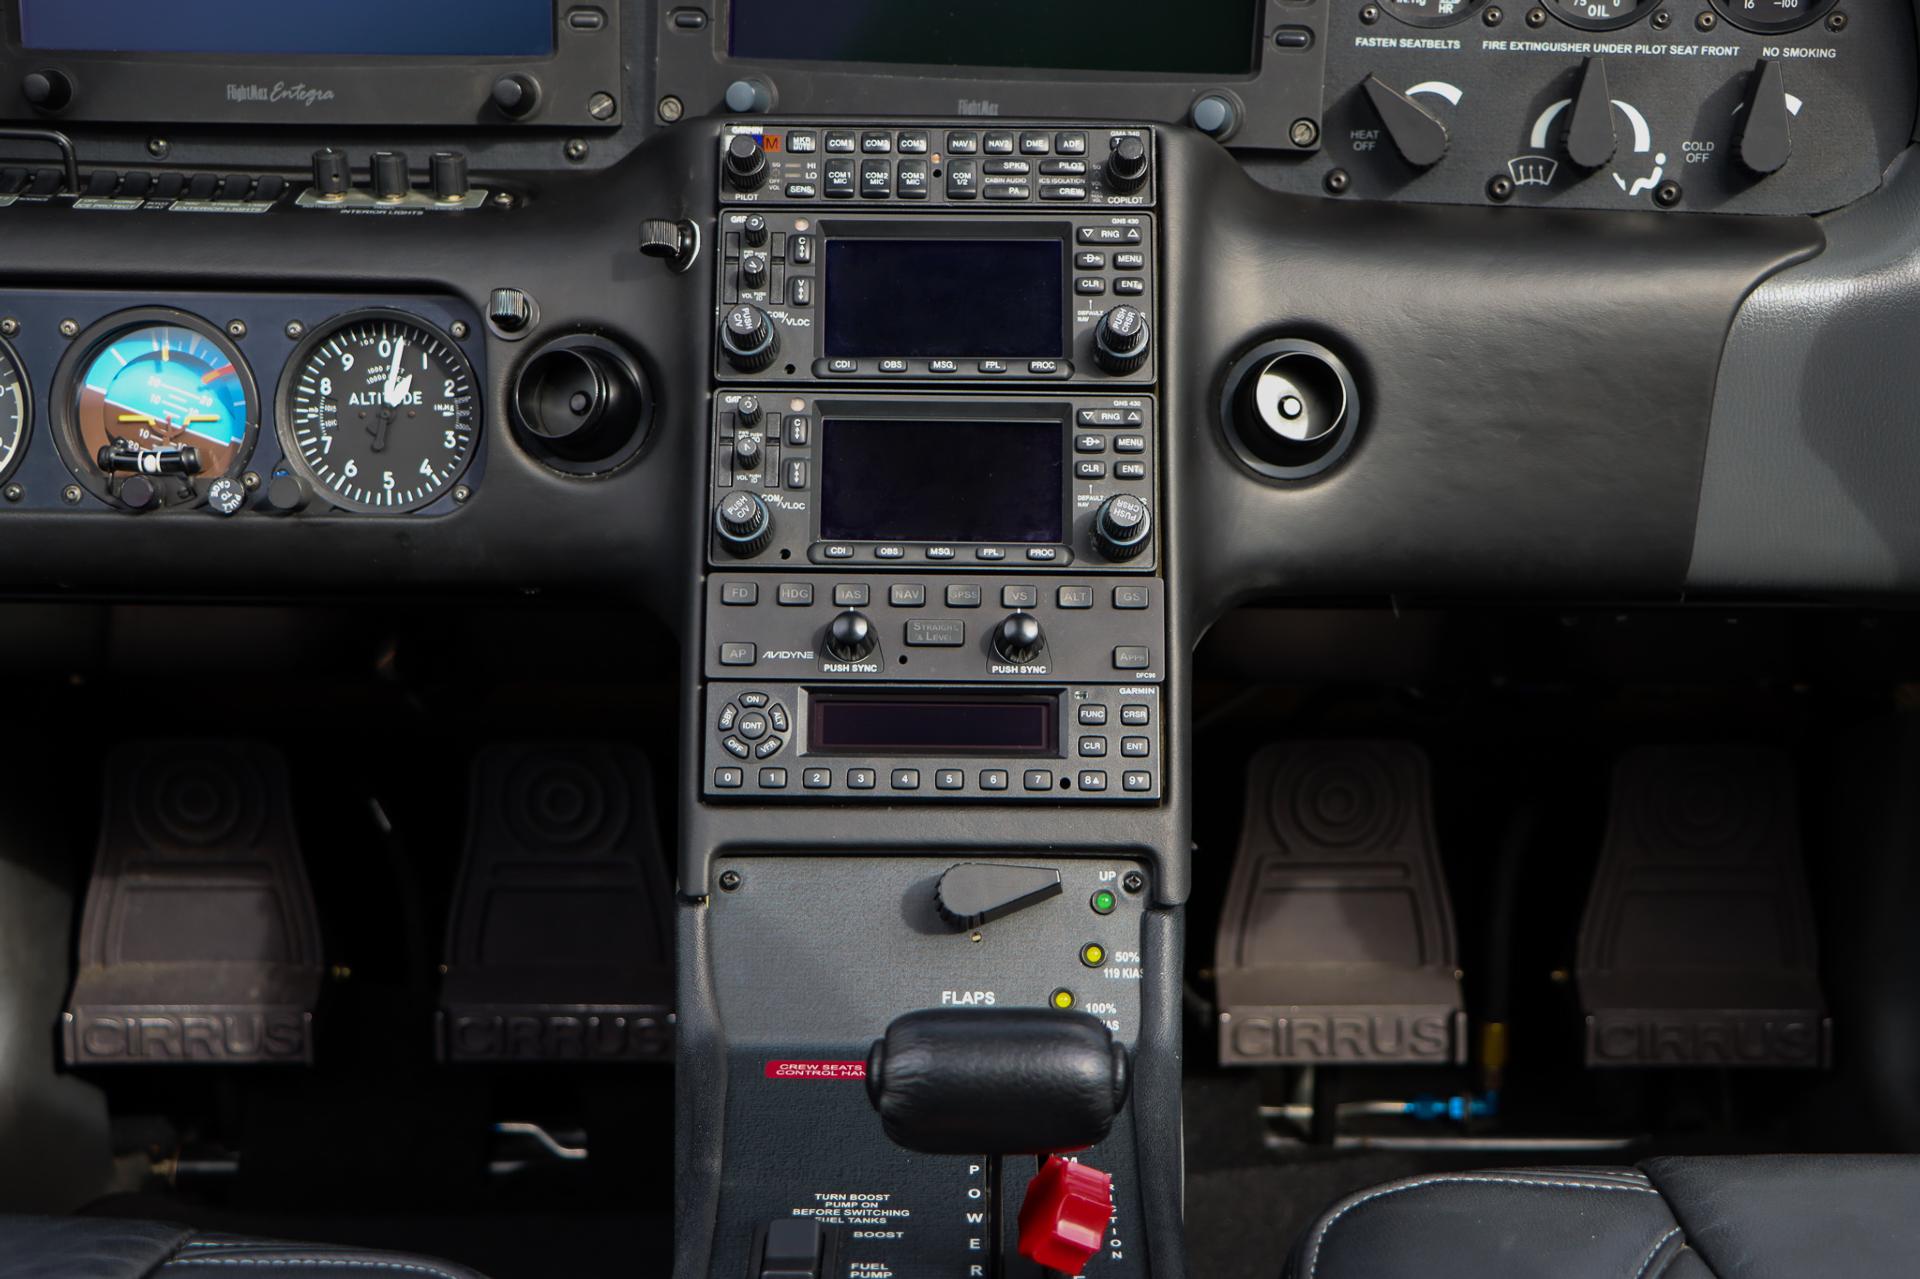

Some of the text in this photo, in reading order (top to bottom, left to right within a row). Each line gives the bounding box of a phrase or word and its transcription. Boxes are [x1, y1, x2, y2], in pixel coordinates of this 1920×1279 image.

[1438, 4, 1454, 14] HR
[1587, 5, 1610, 17] OIL
[1355, 37, 1461, 50] FASTEN SEATBELTS
[1482, 40, 1740, 57] FIRE EXTINGUISHER UNDER PILOT SEAT FRONT
[1762, 47, 1836, 59] NO SMOKING
[270, 80, 335, 107] Entegra
[1350, 130, 1380, 139] HEAT
[765, 138, 778, 149] M
[1353, 141, 1376, 151] OFF
[1682, 141, 1714, 151] COLD
[1686, 153, 1709, 163] OFF
[1107, 196, 1143, 204] COPILOT
[1101, 230, 1119, 238] RNG
[1118, 255, 1142, 263] MENU
[1082, 280, 1099, 288] CLR
[742, 308, 753, 330] PUSH
[1112, 308, 1127, 329] PUSH
[1121, 311, 1135, 332] CRSR
[379, 340, 391, 358] 0
[341, 353, 354, 372] 9
[985, 361, 1000, 369] FPL
[1031, 361, 1055, 369] PROC
[320, 377, 332, 395] 8
[444, 379, 455, 397] 2
[348, 391, 423, 405] ALTIDE
[139, 428, 150, 439] 10
[444, 430, 456, 448] 3
[1118, 438, 1143, 446] MENU
[321, 436, 332, 454] 7
[344, 459, 357, 477] 6
[419, 458, 432, 476] 4
[1082, 464, 1099, 472] CLR
[1122, 465, 1138, 473] ENT
[383, 471, 395, 489] 5
[727, 495, 748, 515] PUSH
[1116, 499, 1139, 512] CRSR
[1113, 508, 1137, 521] PUSH
[830, 547, 846, 555] CDI
[1030, 548, 1054, 556] PROC
[732, 589, 748, 597] FD
[782, 589, 809, 598] HDG
[841, 590, 861, 599] IAS
[895, 590, 919, 599] NAV
[1012, 591, 1027, 600] VS
[1063, 592, 1086, 601] ALT
[1123, 592, 1140, 600] GS
[730, 649, 746, 658] AP
[762, 651, 814, 659] AVIDYNE
[823, 664, 877, 673] PUSH SYNC
[992, 666, 1047, 674] PUSH SYNC
[727, 740, 743, 752] OFF
[761, 741, 777, 753] VFR
[1083, 742, 1100, 750] CLR
[1126, 742, 1143, 750] ENT
[724, 774, 731, 782] 0
[813, 774, 820, 782] 2
[857, 774, 864, 782] 3
[901, 775, 908, 783] 4
[946, 775, 952, 783] 5
[990, 775, 997, 783] 6
[1084, 776, 1091, 784] 8
[1128, 776, 1135, 784] 9
[1099, 871, 1116, 881] UP
[1115, 951, 1140, 962] 50%
[1103, 968, 1120, 978] 119
[942, 991, 995, 1005] FLAPS
[1085, 1003, 1117, 1014] 100%
[84, 1015, 304, 1057] CIRRUS
[1231, 1016, 1445, 1057] CIRRUS
[1599, 1021, 1811, 1060] CIRRUS
[815, 1193, 846, 1201] TURN
[792, 1208, 910, 1217] BEFORE SWITCHING
[966, 1165, 983, 1276] POWER
[853, 1231, 904, 1239] BOOST
[851, 1263, 888, 1271] FUEL
[851, 1271, 893, 1279] PUMP
